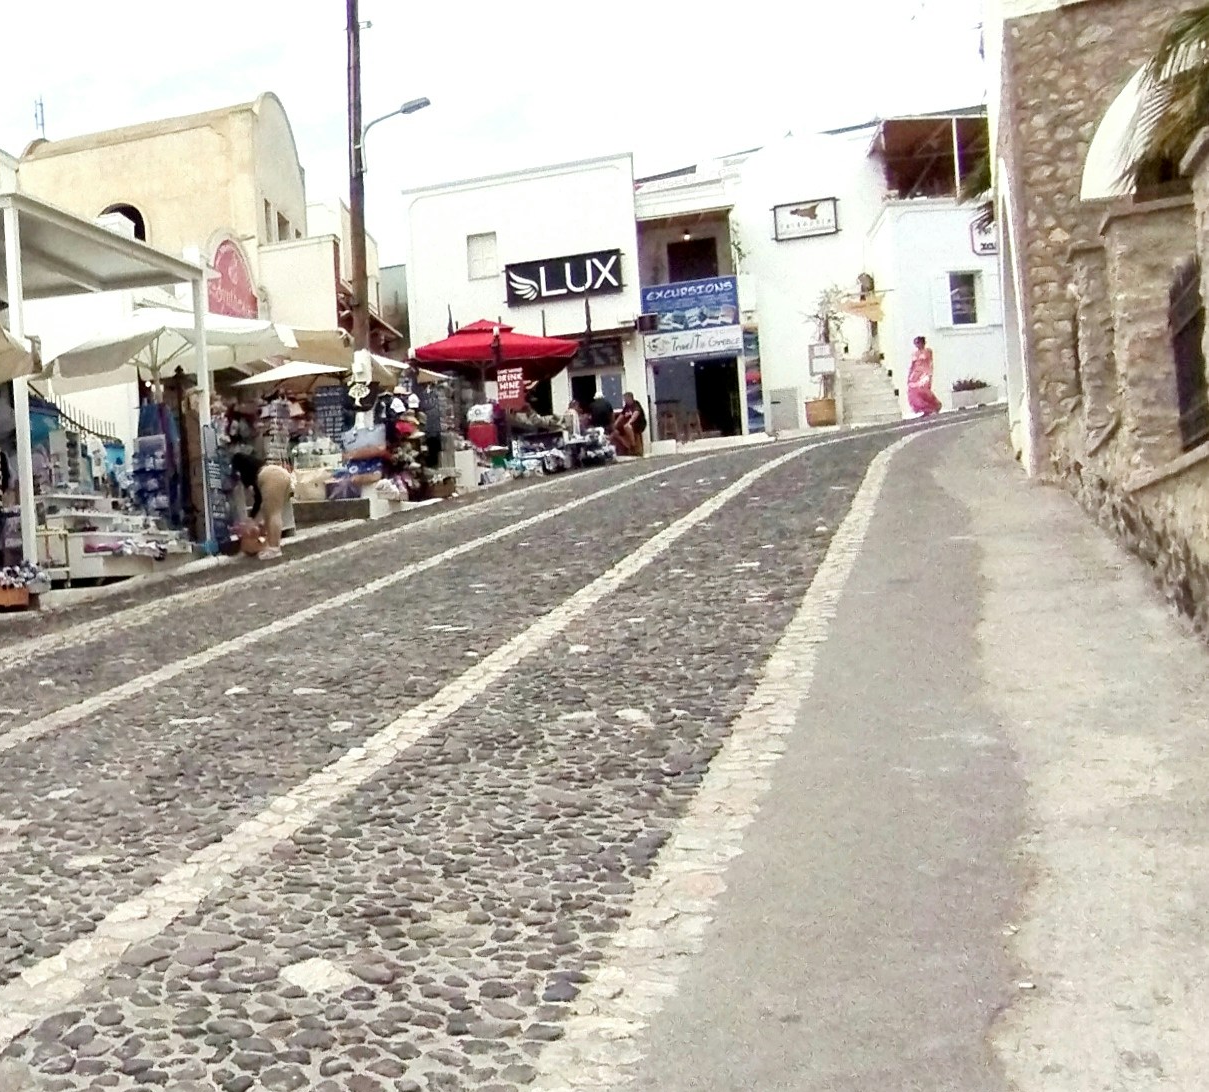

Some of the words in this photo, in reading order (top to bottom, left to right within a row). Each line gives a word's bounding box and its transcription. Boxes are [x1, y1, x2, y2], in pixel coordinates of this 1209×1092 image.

[539, 255, 619, 297] LUX
[646, 281, 733, 301] EXCURSIONS
[497, 373, 523, 382] DRINK
[499, 380, 521, 390] WINE
